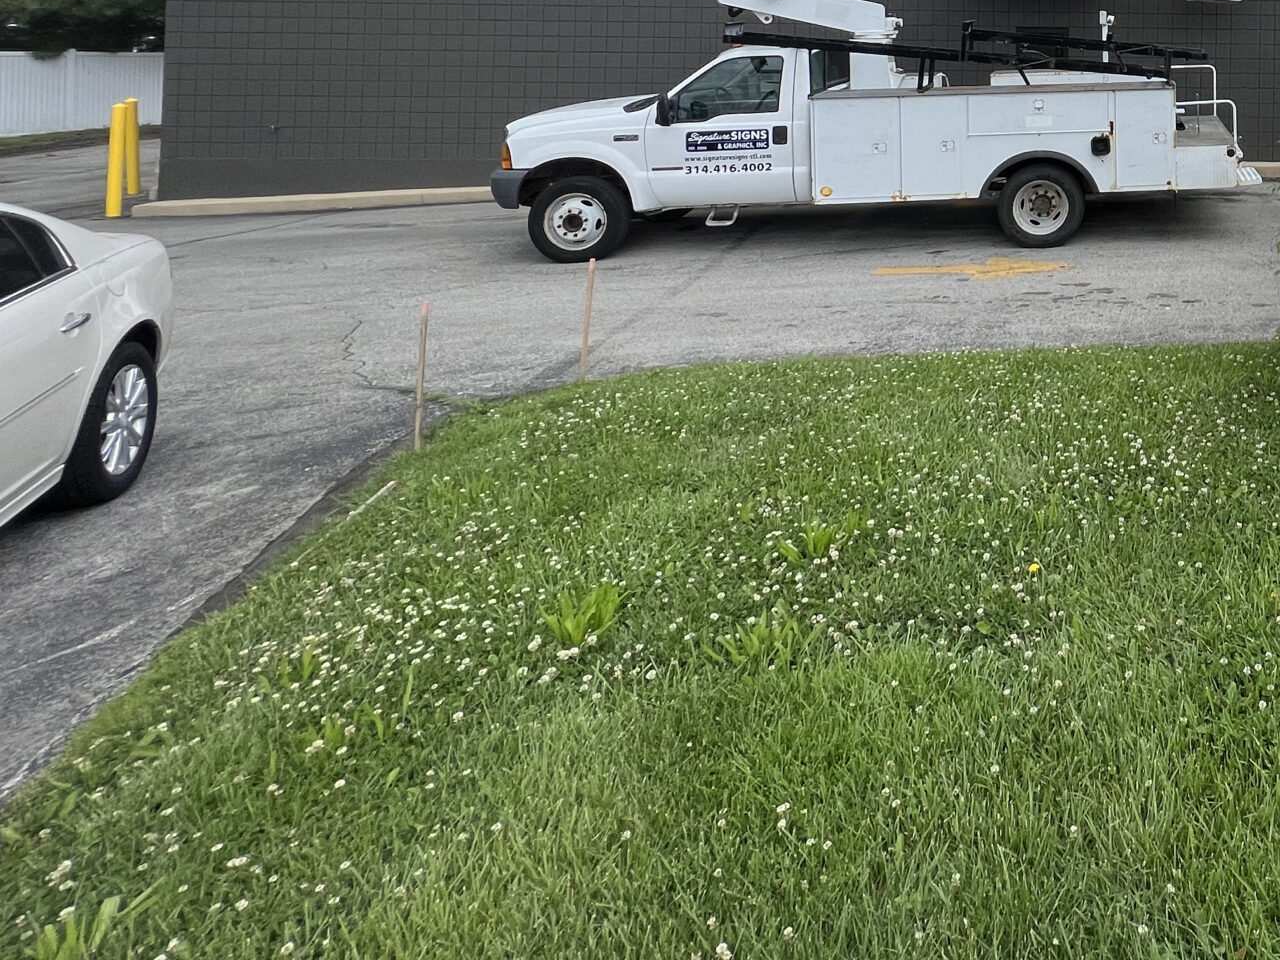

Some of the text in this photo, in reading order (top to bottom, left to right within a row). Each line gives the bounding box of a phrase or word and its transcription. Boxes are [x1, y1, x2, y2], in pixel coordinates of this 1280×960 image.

[688, 130, 767, 144] Signature SIGNS
[685, 162, 772, 175] 314.416.4002
